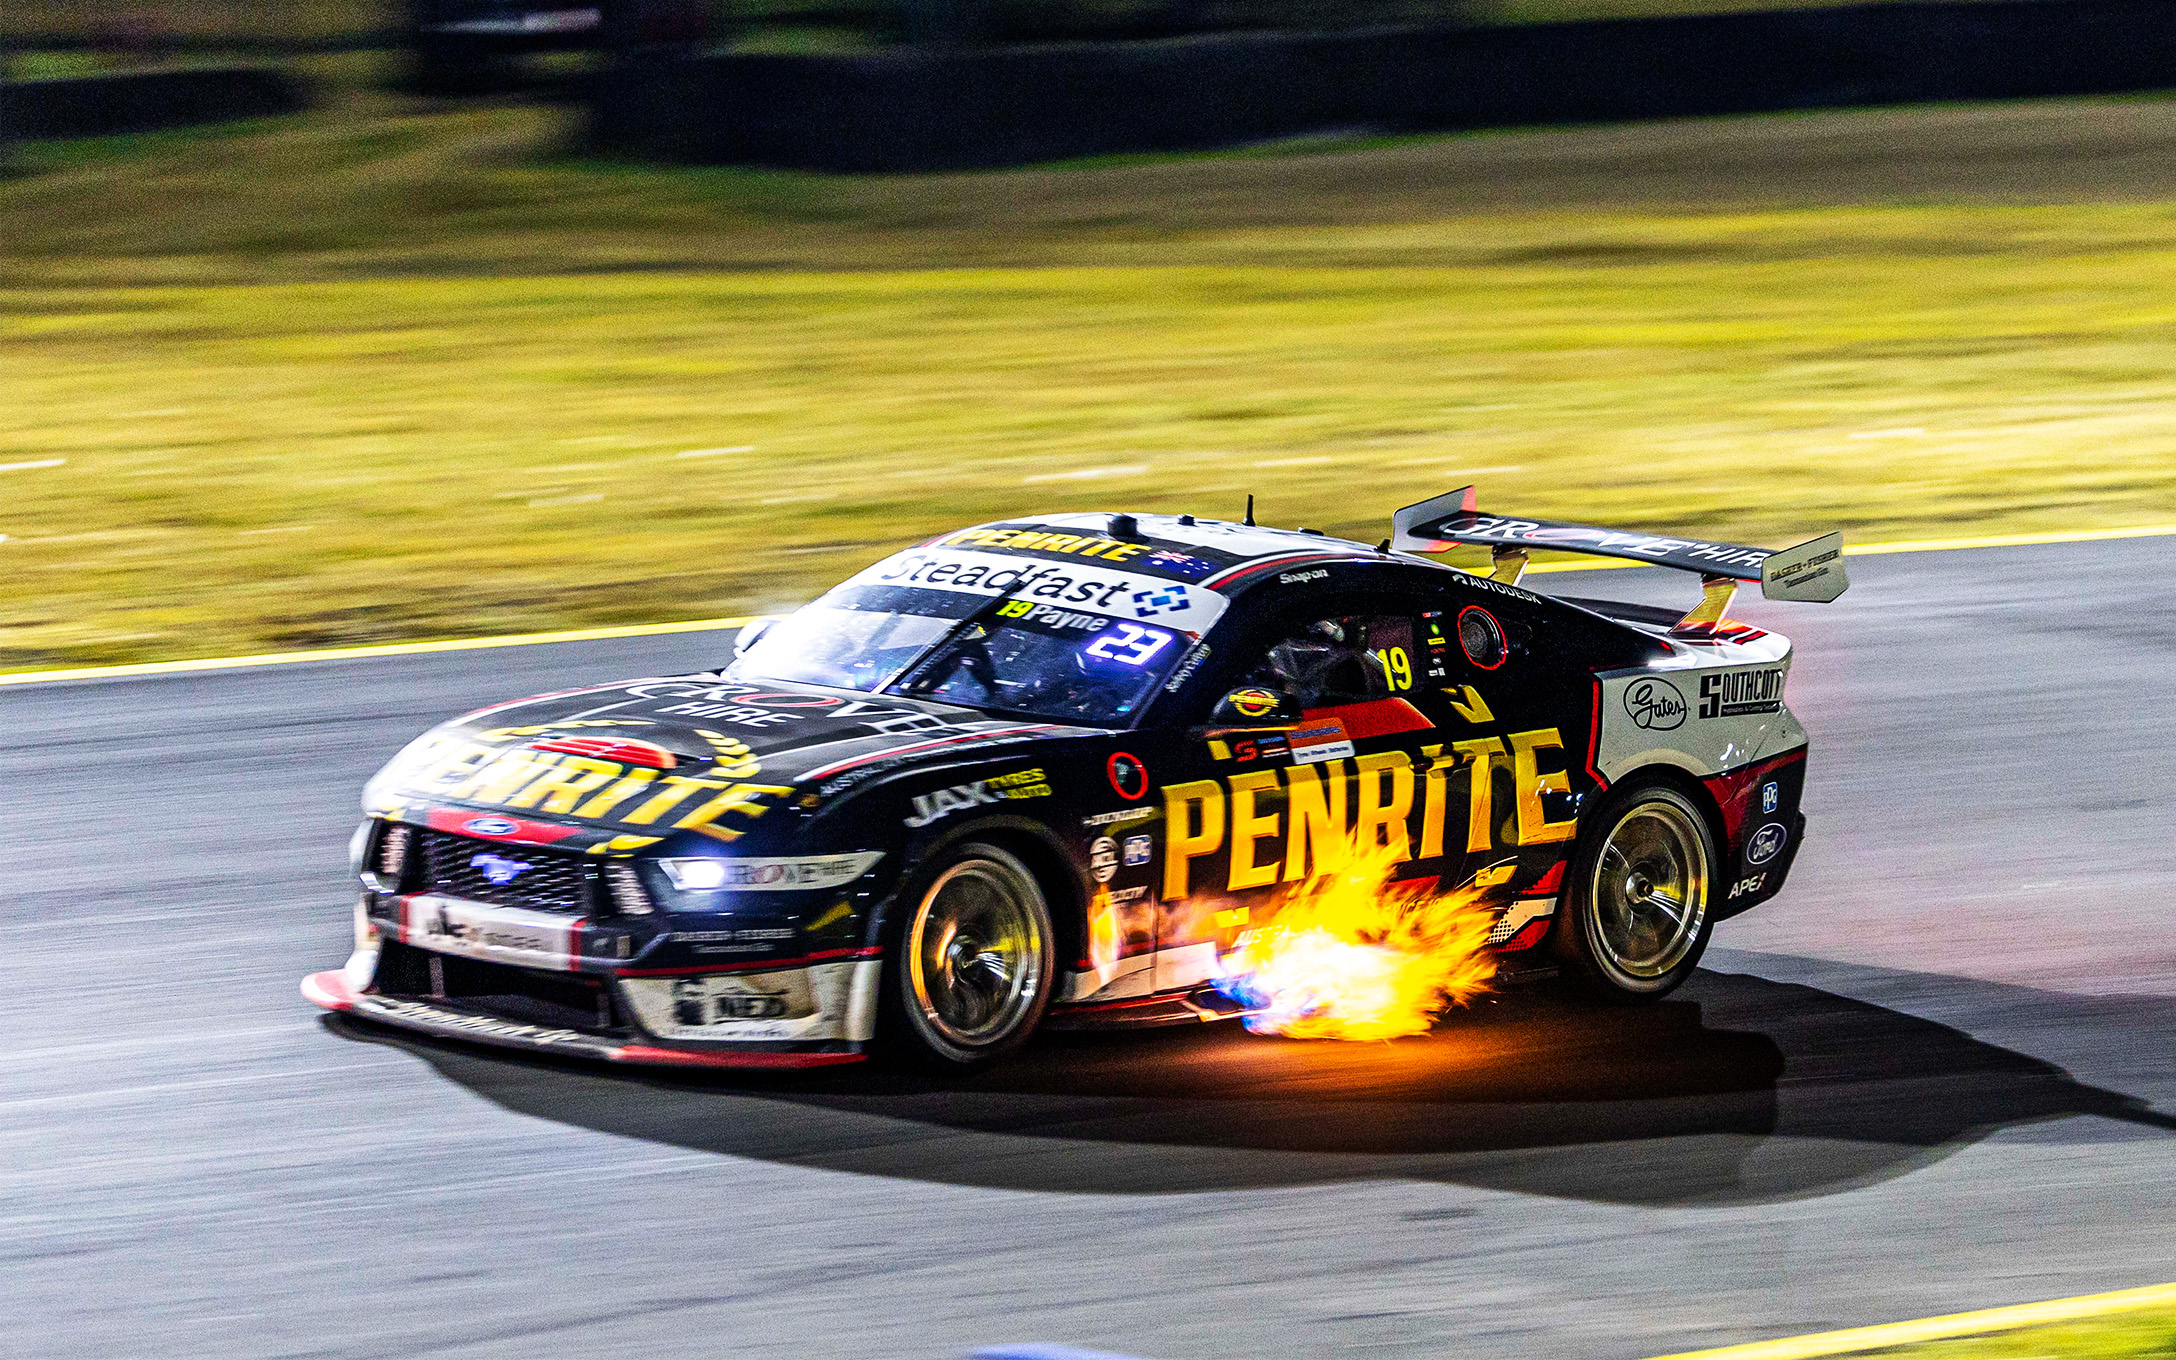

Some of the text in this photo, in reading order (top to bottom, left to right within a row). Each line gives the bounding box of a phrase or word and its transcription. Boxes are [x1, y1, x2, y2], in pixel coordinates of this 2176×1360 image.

[946, 529, 1152, 562] PENRITE
[1688, 544, 1764, 568] HIR
[881, 555, 1130, 607] Steadfast
[1469, 576, 1541, 604] AUTODESK
[1086, 624, 1171, 665] 23
[1377, 646, 1413, 691] 19
[655, 701, 804, 727] HIRE
[1629, 681, 1687, 730] Gates
[1699, 669, 1783, 719] SOUTHCOTT
[400, 738, 796, 841] PENRITE
[903, 780, 999, 828] JAX
[1160, 727, 1578, 901] PENRITE
[1753, 829, 1780, 859] Ford
